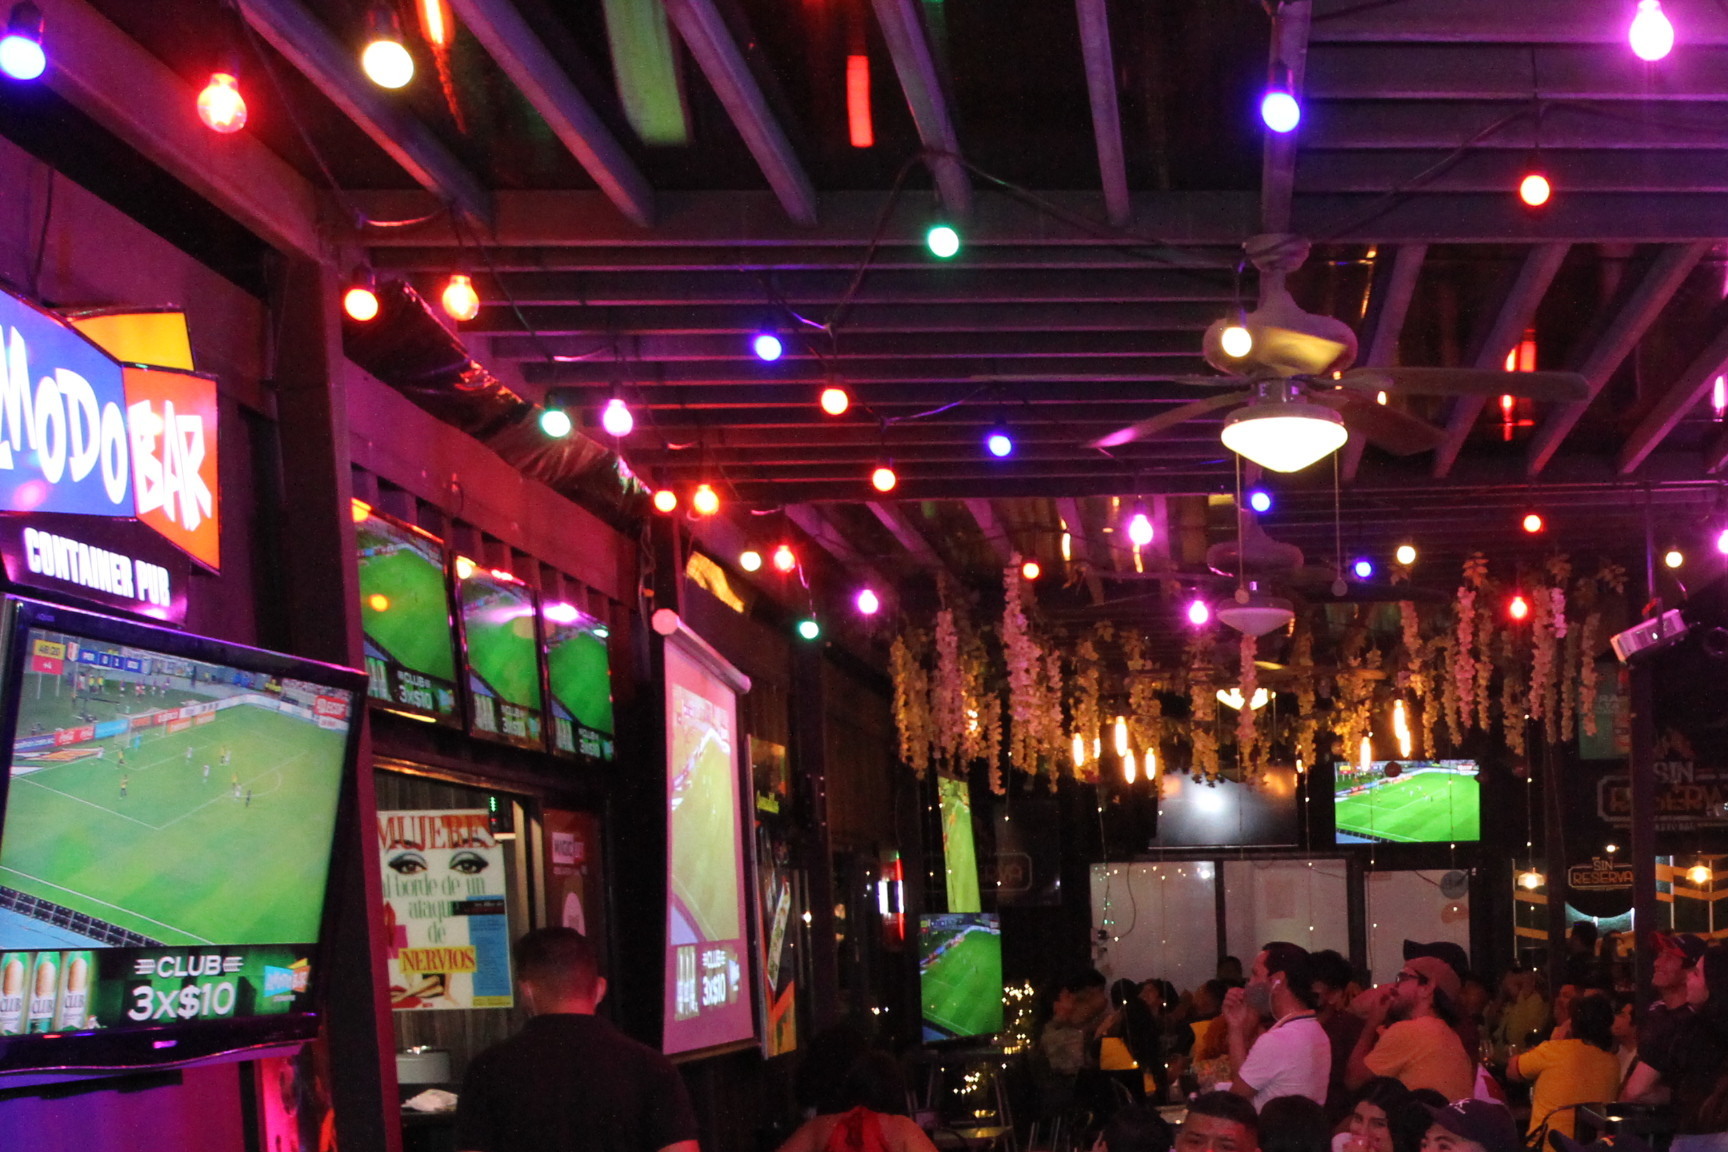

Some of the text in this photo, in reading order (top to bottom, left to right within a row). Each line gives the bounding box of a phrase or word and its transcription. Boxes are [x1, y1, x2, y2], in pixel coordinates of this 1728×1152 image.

[24, 527, 171, 607] CONTAINER PUB
[1593, 860, 1614, 871] SIN
[393, 873, 438, 898] borde
[442, 875, 460, 897] de
[467, 875, 485, 895] un
[1573, 871, 1634, 885] RESERVA
[409, 899, 455, 920] ataqu
[427, 921, 447, 944] de
[157, 955, 222, 978] CLUB
[402, 948, 476, 972] NERVIOS
